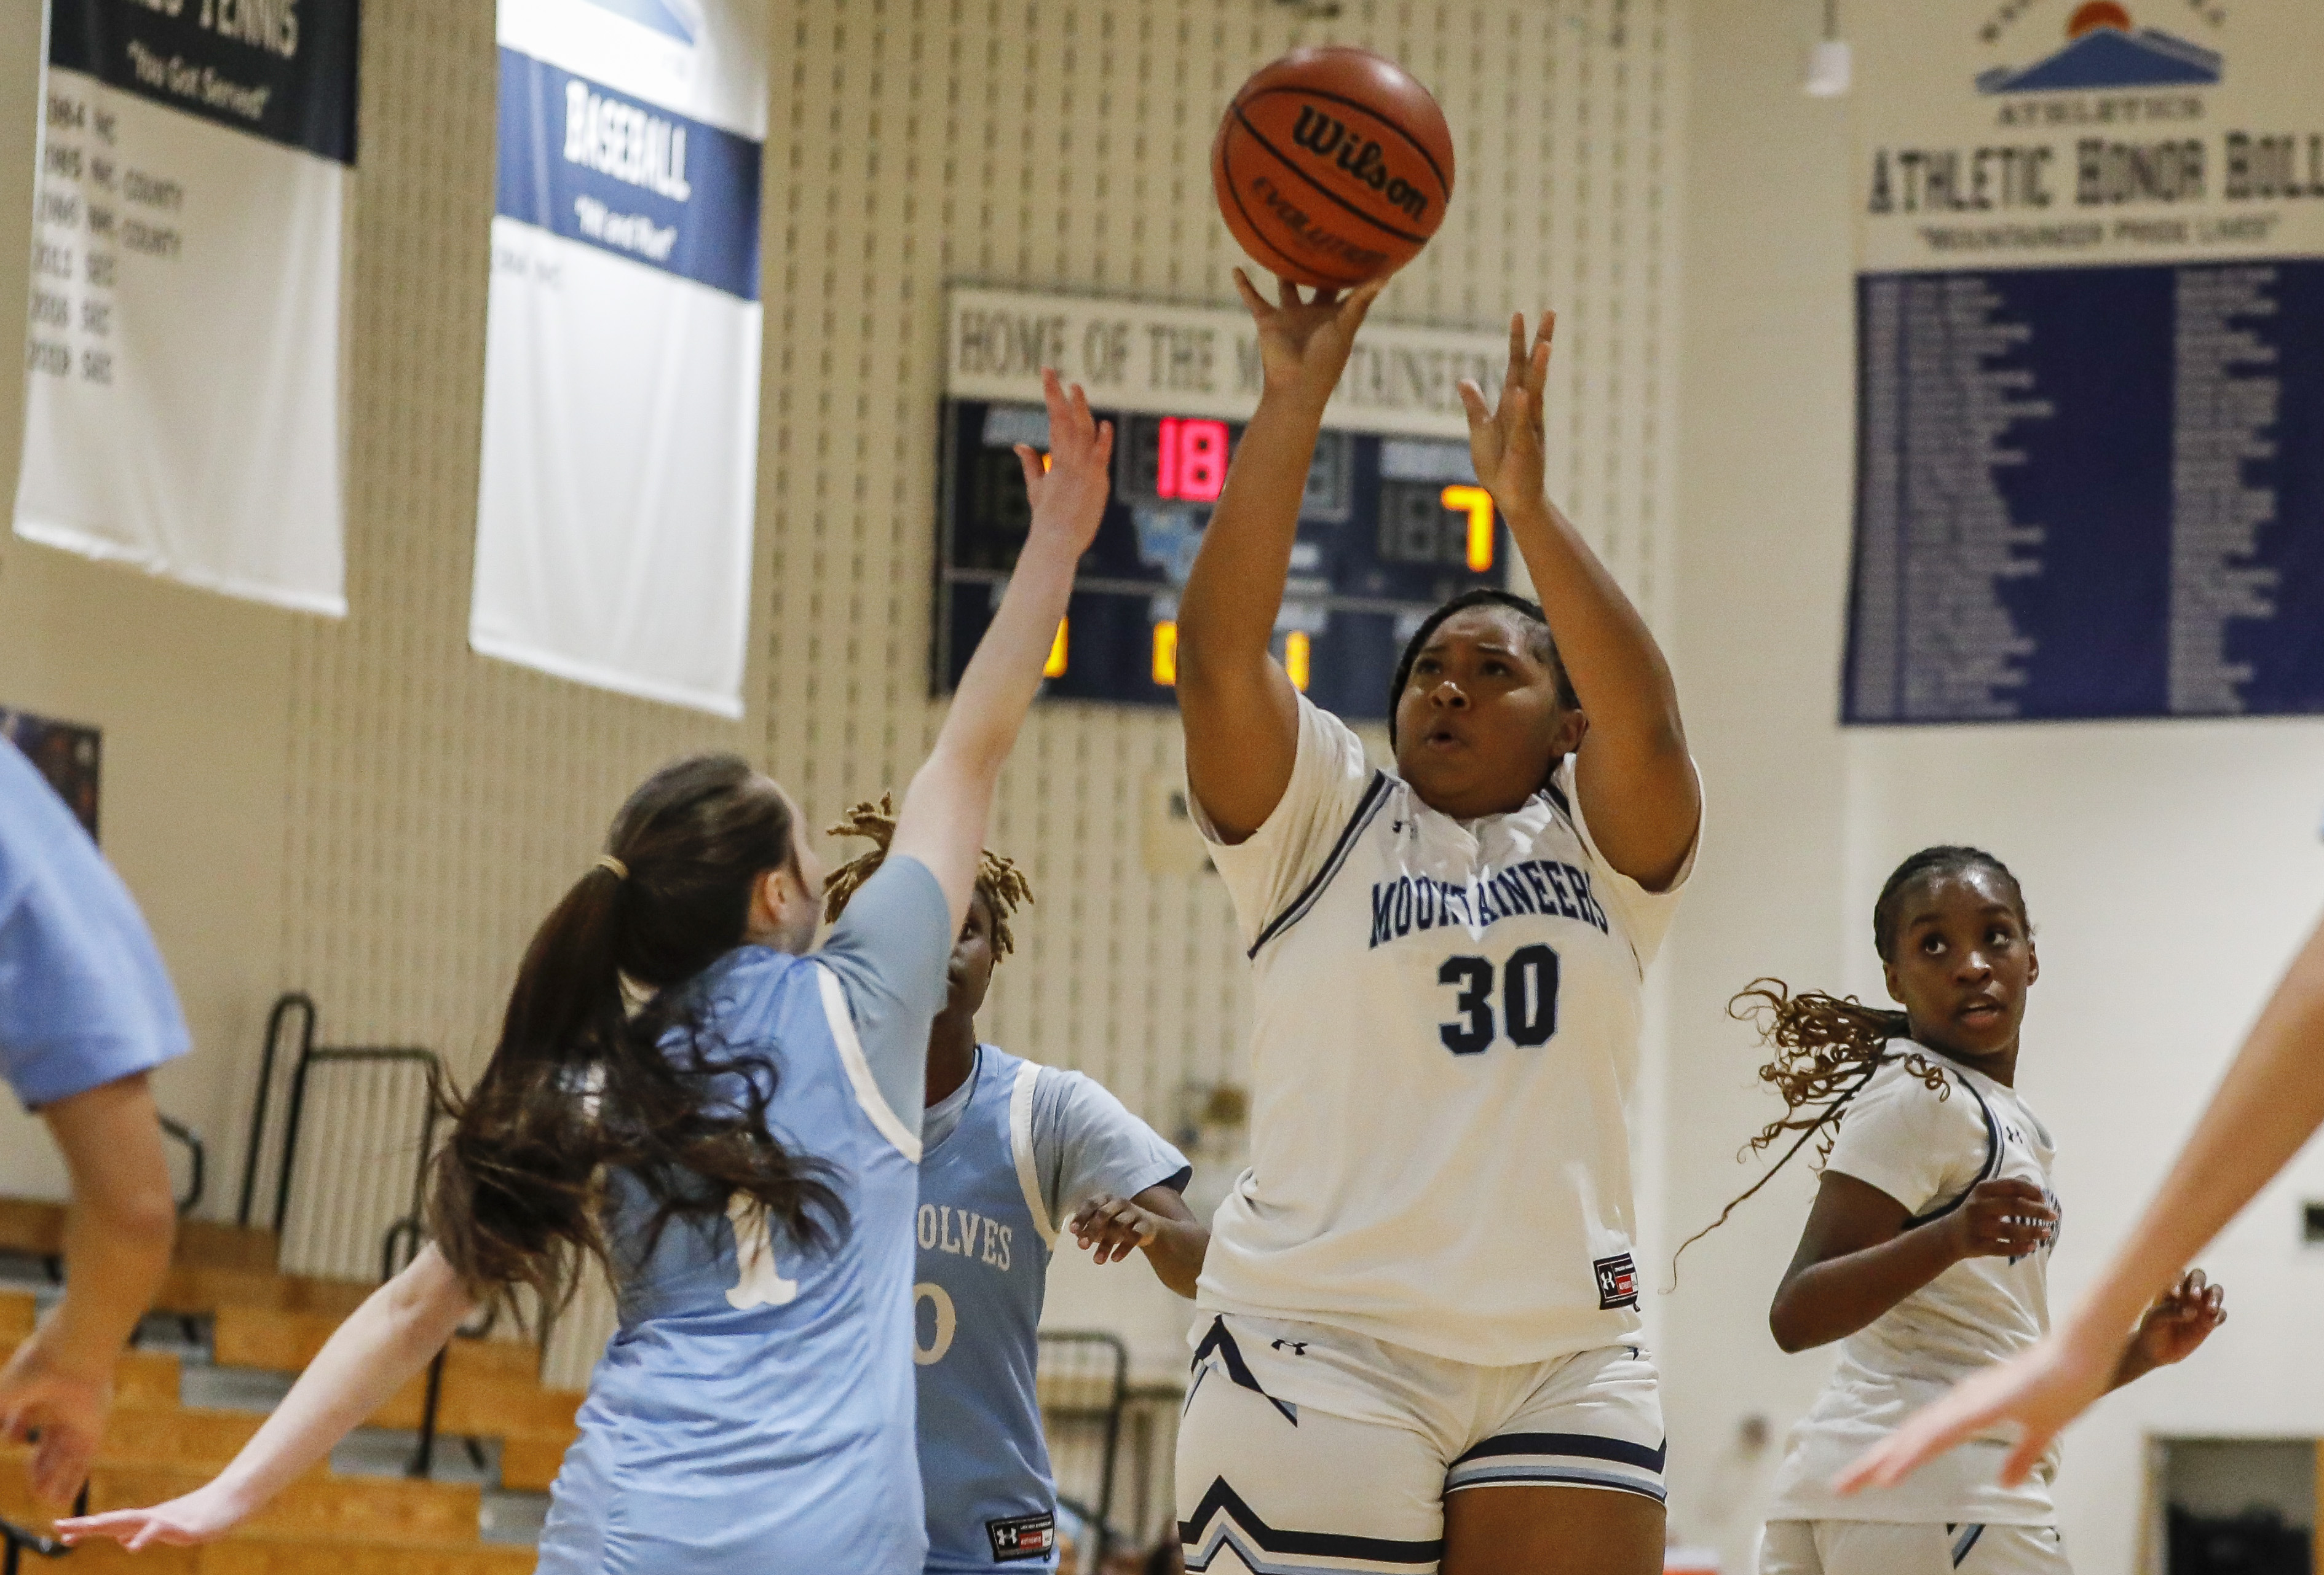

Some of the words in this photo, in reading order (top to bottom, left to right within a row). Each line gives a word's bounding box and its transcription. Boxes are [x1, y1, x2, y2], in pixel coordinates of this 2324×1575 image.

[564, 79, 691, 202] BASEBALL
[1293, 104, 1429, 223] Wilson
[1868, 145, 2053, 215] ATHLETIC
[2075, 136, 2207, 207] HONOR
[960, 308, 1067, 379] HOME
[1082, 317, 1129, 385] OF
[1146, 321, 1217, 393] THE
[1157, 417, 1228, 503] 18
[1441, 485, 1494, 572] 7
[1437, 942, 1562, 1057] 30
[917, 1203, 1013, 1272] OLVES
